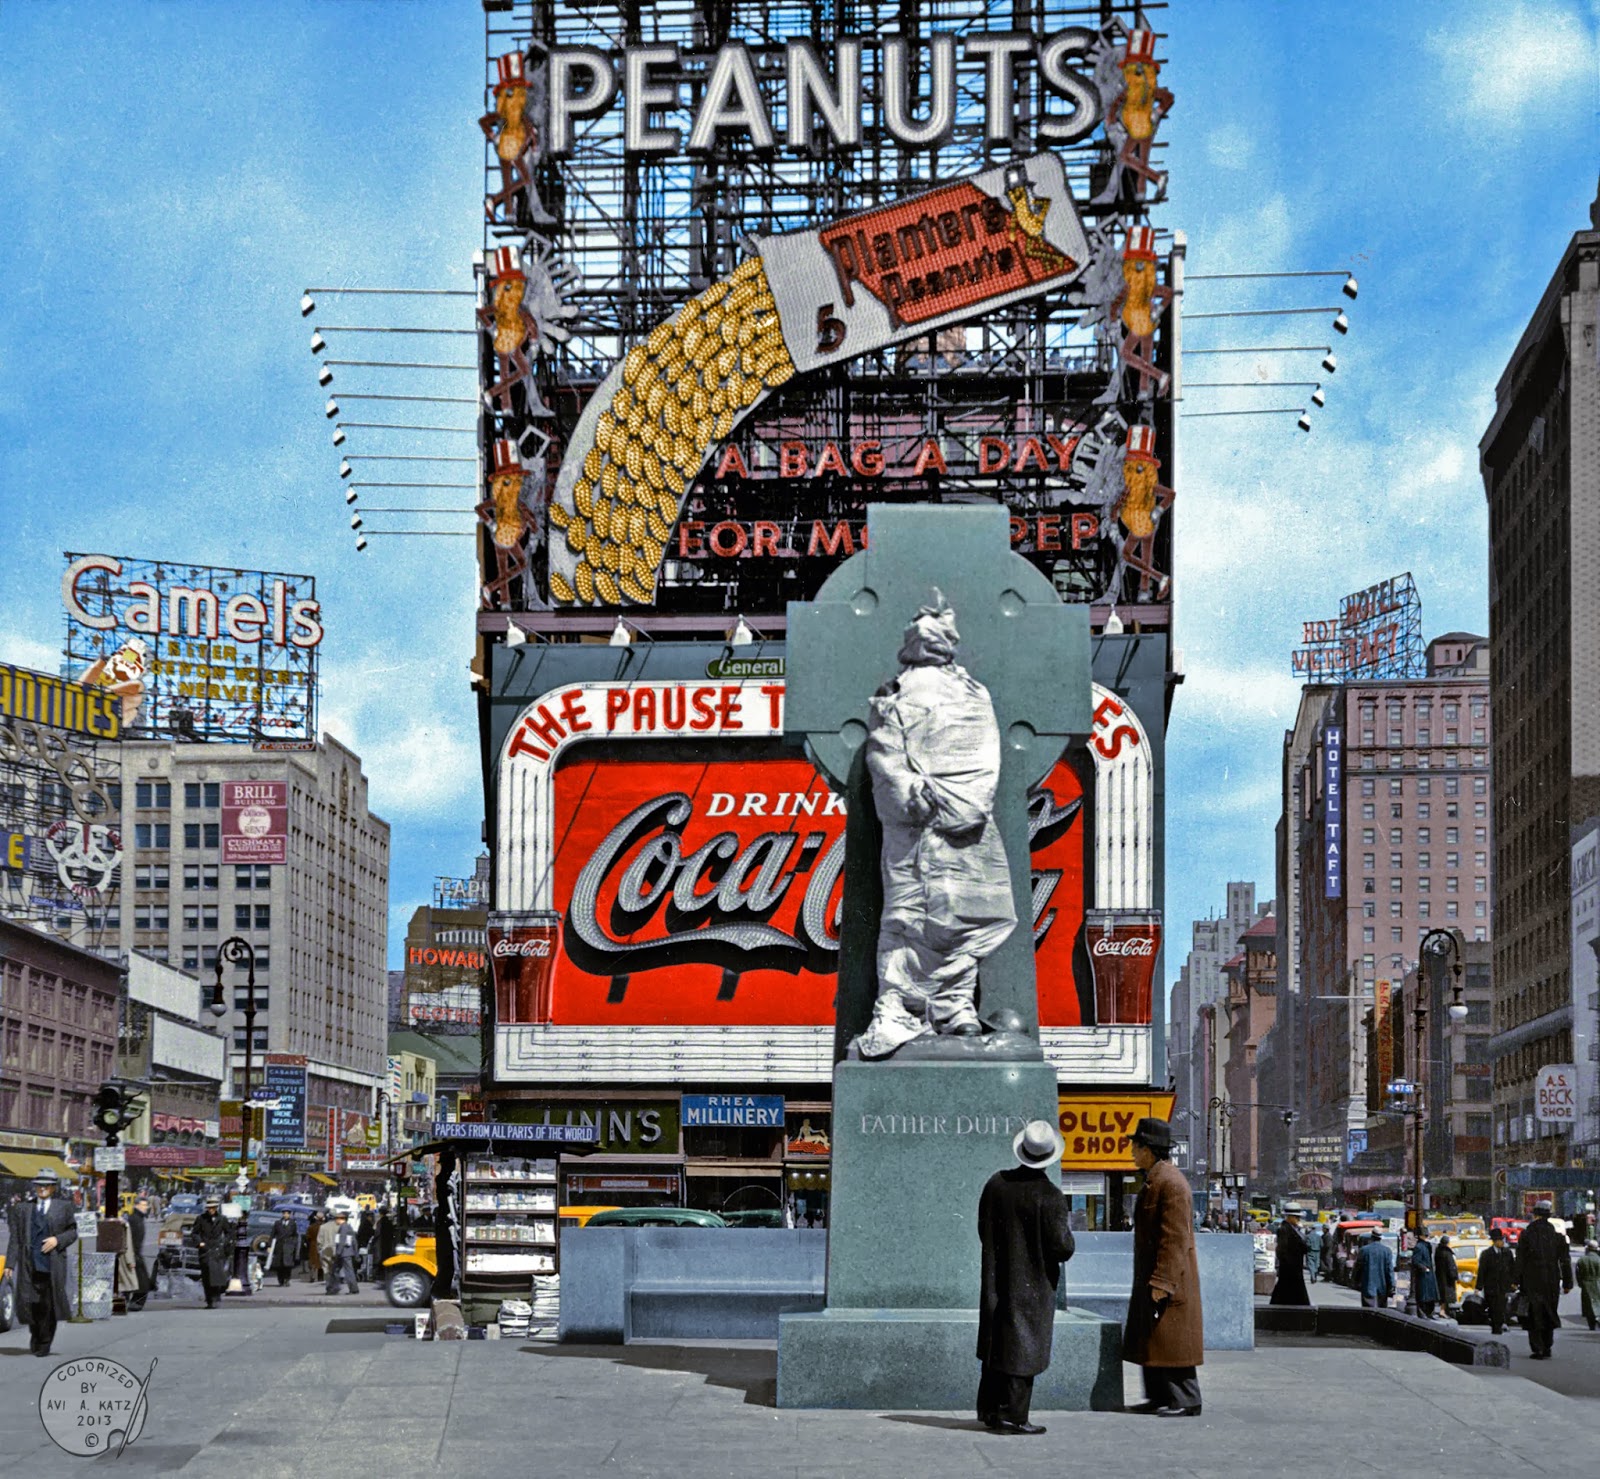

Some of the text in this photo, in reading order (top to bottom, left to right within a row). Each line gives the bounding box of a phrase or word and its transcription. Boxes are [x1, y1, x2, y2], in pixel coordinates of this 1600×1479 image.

[547, 28, 1101, 154] PEANUTS
[715, 435, 1080, 479] A BAG A DAY
[678, 520, 783, 557] FOR
[61, 553, 324, 648] Camels
[1346, 579, 1401, 624] HOTEL
[1346, 623, 1399, 669] TAFT
[718, 658, 784, 675] General
[508, 689, 592, 761] THE
[606, 686, 743, 732] PAUSE
[234, 785, 277, 799] BRILL
[706, 792, 848, 817] DRINK
[1327, 730, 1340, 888] HOTEL TAFT
[244, 826, 267, 834] RENT
[228, 839, 274, 847] CUSHMAN
[493, 938, 551, 958] Coca-Cola
[1093, 937, 1154, 957] Coca-Cola
[409, 947, 485, 970] HOWAR
[1395, 1084, 1404, 1092] 47
[1405, 1084, 1414, 1092] ST
[1546, 1074, 1567, 1087] A.S.
[708, 1096, 755, 1106] RHEA
[1539, 1088, 1574, 1105] BECK
[687, 1107, 780, 1124] MILLINERY
[1541, 1107, 1572, 1118] SHOE
[435, 1123, 593, 1142] PAPERS FROM ALL PARTS OF THE WORLD
[861, 1114, 1032, 1135] FATHER DUFFY
[1072, 1136, 1131, 1155] SHOP
